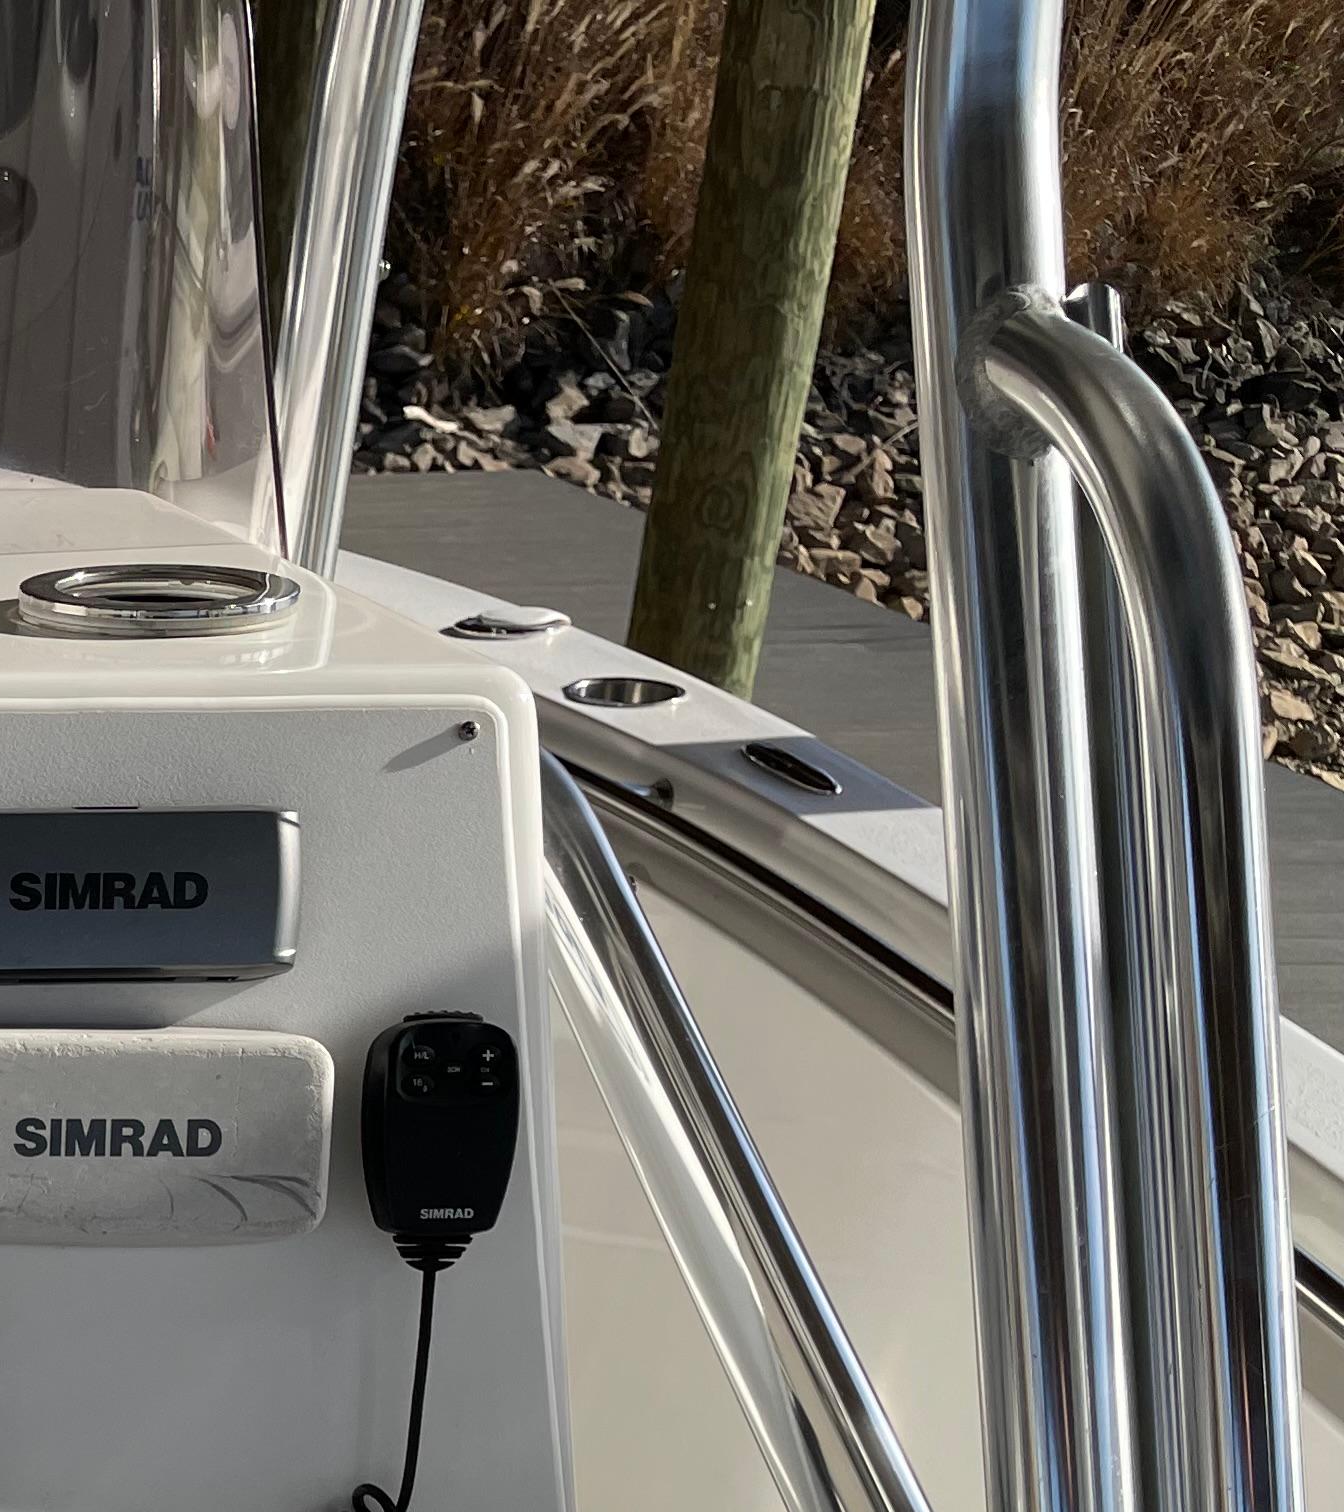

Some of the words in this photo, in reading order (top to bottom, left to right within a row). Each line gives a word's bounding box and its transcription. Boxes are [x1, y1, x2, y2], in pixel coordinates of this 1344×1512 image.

[9, 872, 209, 911] SIMRAD
[13, 1118, 222, 1157] SIMRAD
[419, 1208, 474, 1219] SIMRAD
